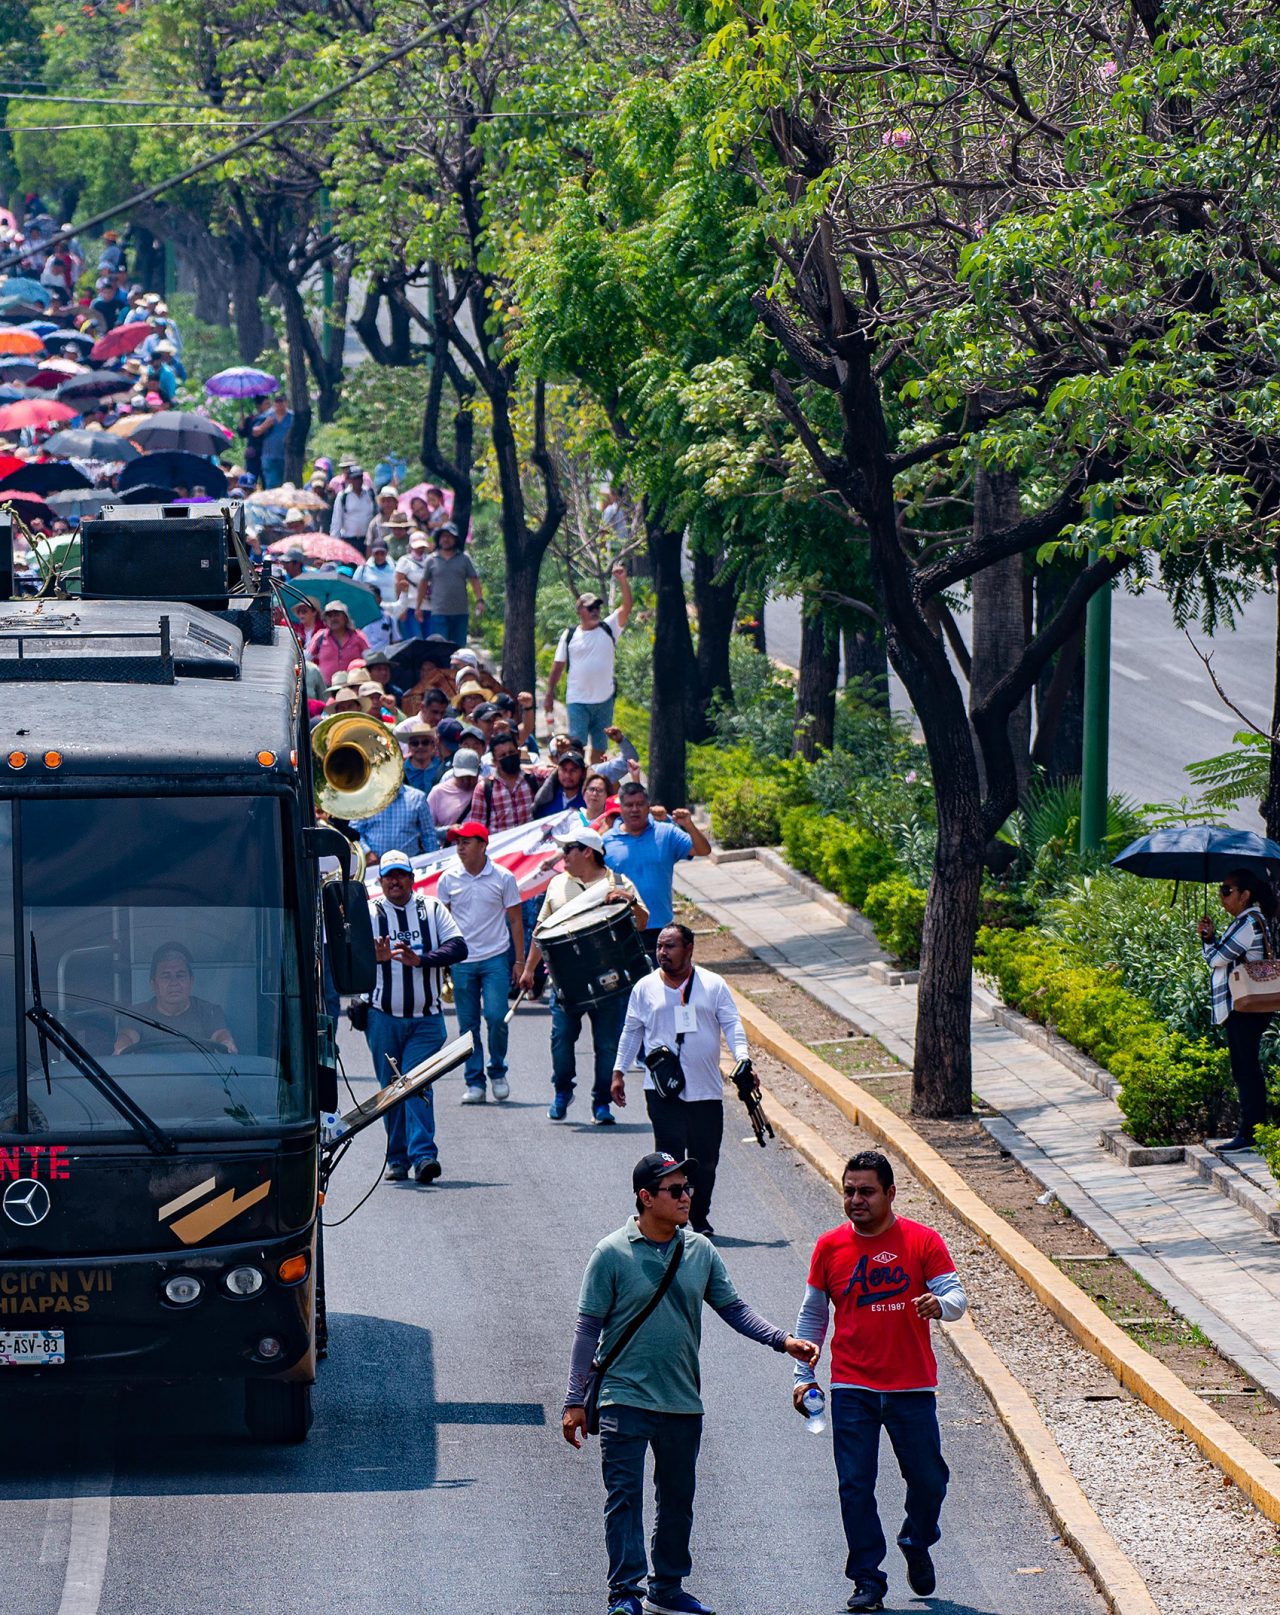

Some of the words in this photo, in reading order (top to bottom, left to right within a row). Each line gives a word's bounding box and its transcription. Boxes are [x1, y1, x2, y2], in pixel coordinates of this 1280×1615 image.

[390, 929, 420, 941] Jeep
[77, 1270, 113, 1292] VII
[843, 1255, 909, 1296] Aero
[0, 1339, 58, 1354] 5-ASV-83
